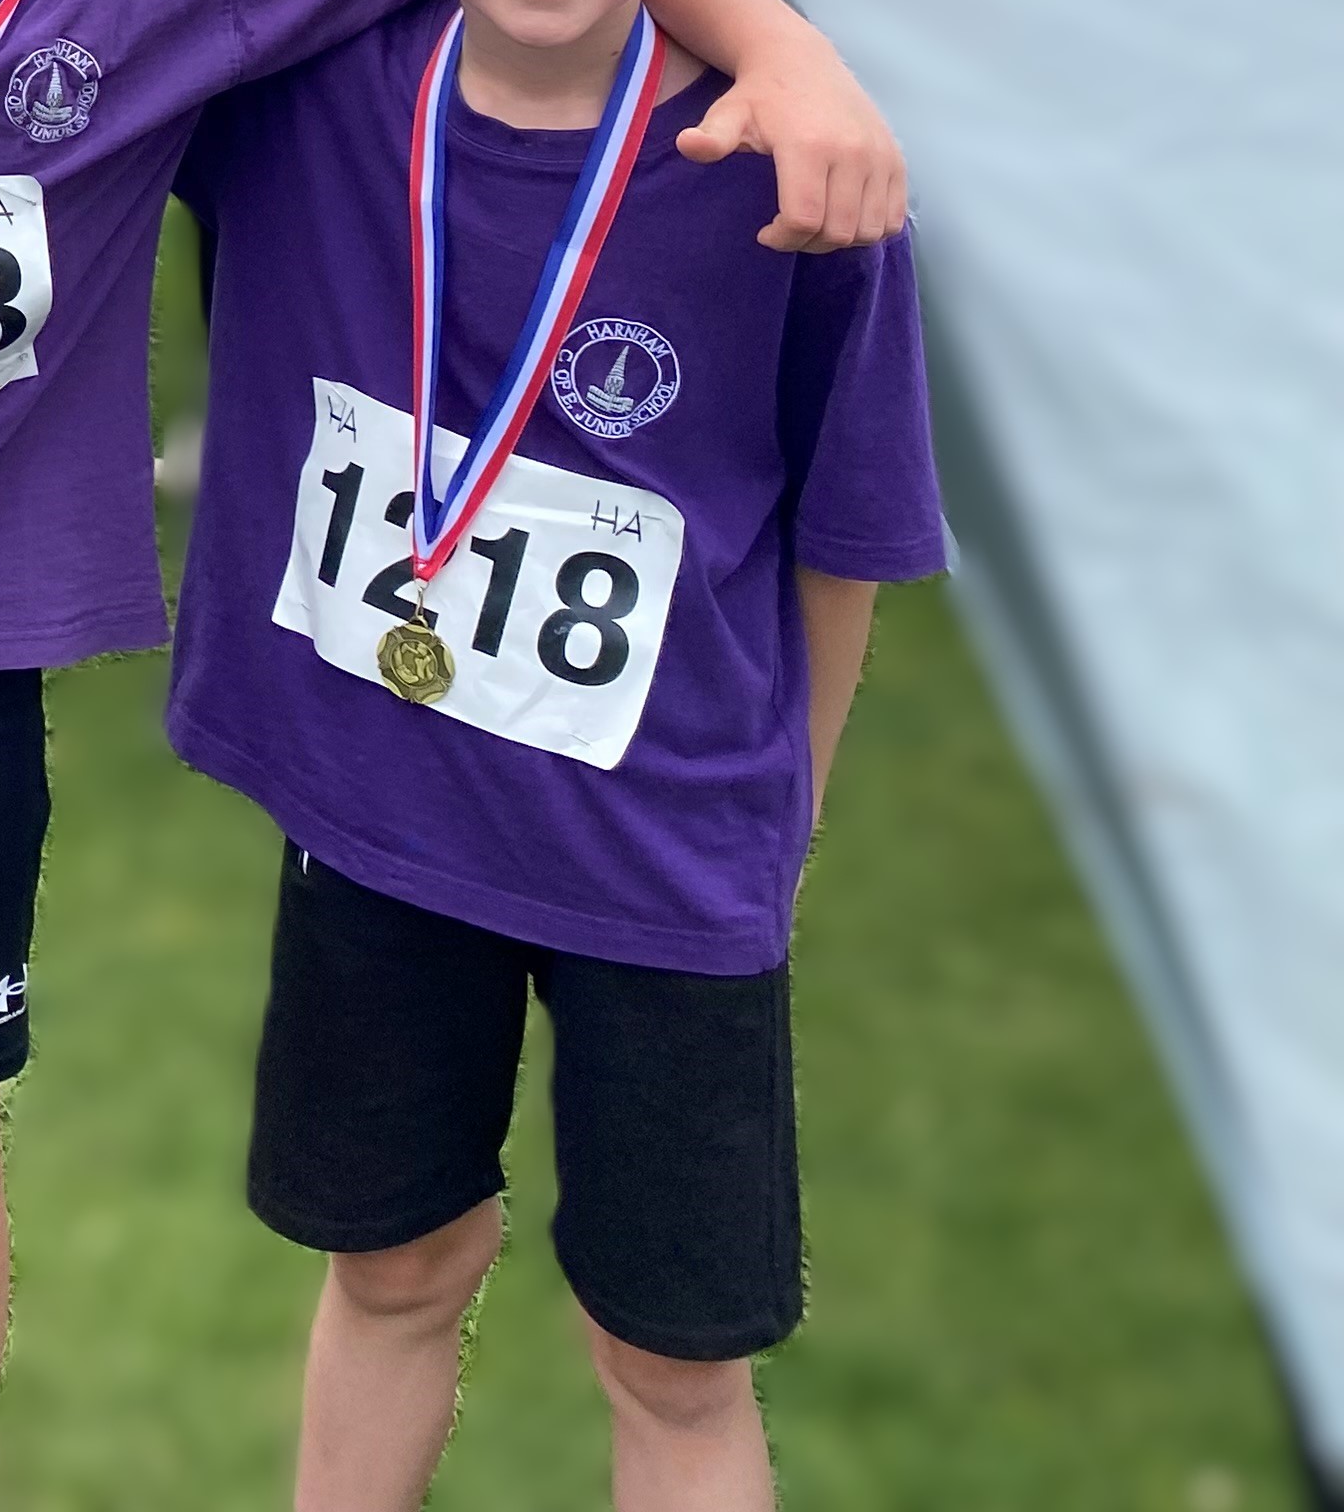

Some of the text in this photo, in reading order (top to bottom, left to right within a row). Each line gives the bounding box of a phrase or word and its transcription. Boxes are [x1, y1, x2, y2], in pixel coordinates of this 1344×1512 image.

[587, 322, 672, 359] HARNHAM
[558, 349, 573, 363] C
[575, 410, 631, 435] JUNIOR
[630, 381, 676, 427] SCHOOL
[327, 394, 358, 443] HA
[591, 500, 643, 543] HA
[317, 461, 640, 687] 1218
